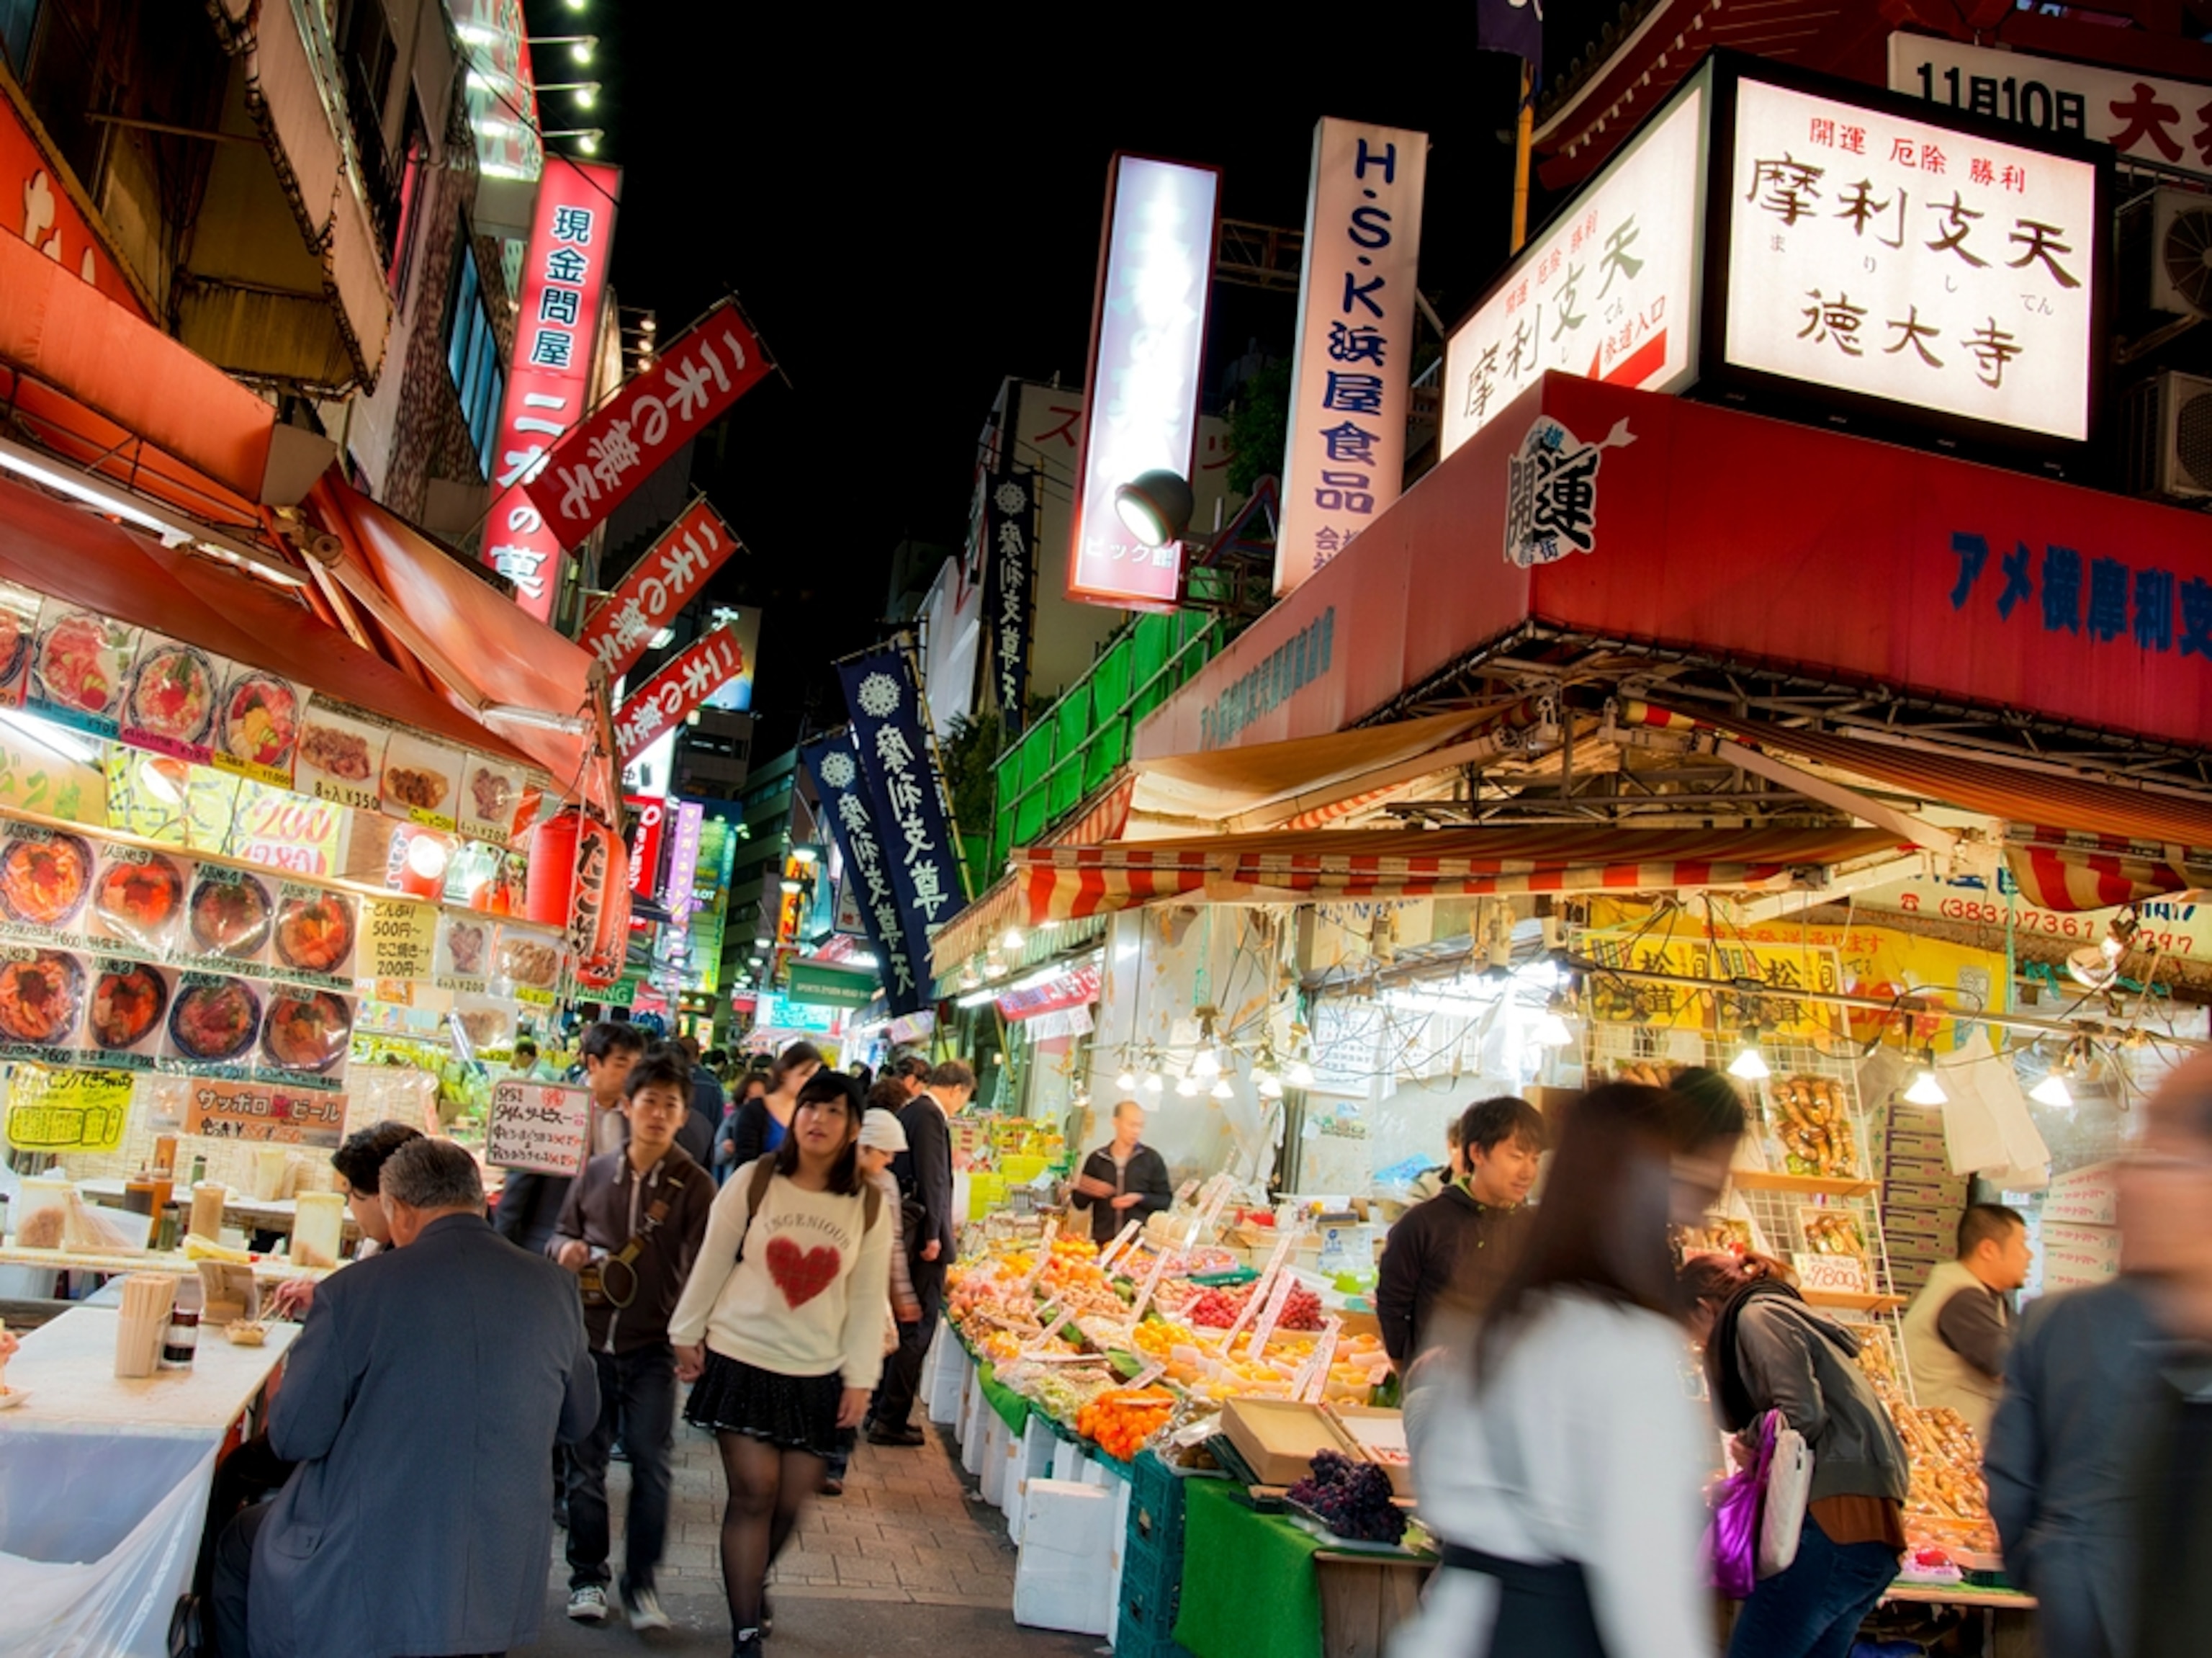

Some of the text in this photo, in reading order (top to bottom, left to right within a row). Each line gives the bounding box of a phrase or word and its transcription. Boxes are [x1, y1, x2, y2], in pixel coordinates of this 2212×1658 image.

[1809, 118, 2027, 194] 開運 厄除 勝利
[1917, 63, 2085, 139] 11月10日
[1745, 151, 2082, 289] 摩利支天
[531, 206, 591, 367] 現金問屋
[1463, 212, 1645, 418] 摩利支天
[1796, 288, 2024, 390] 徳大寺
